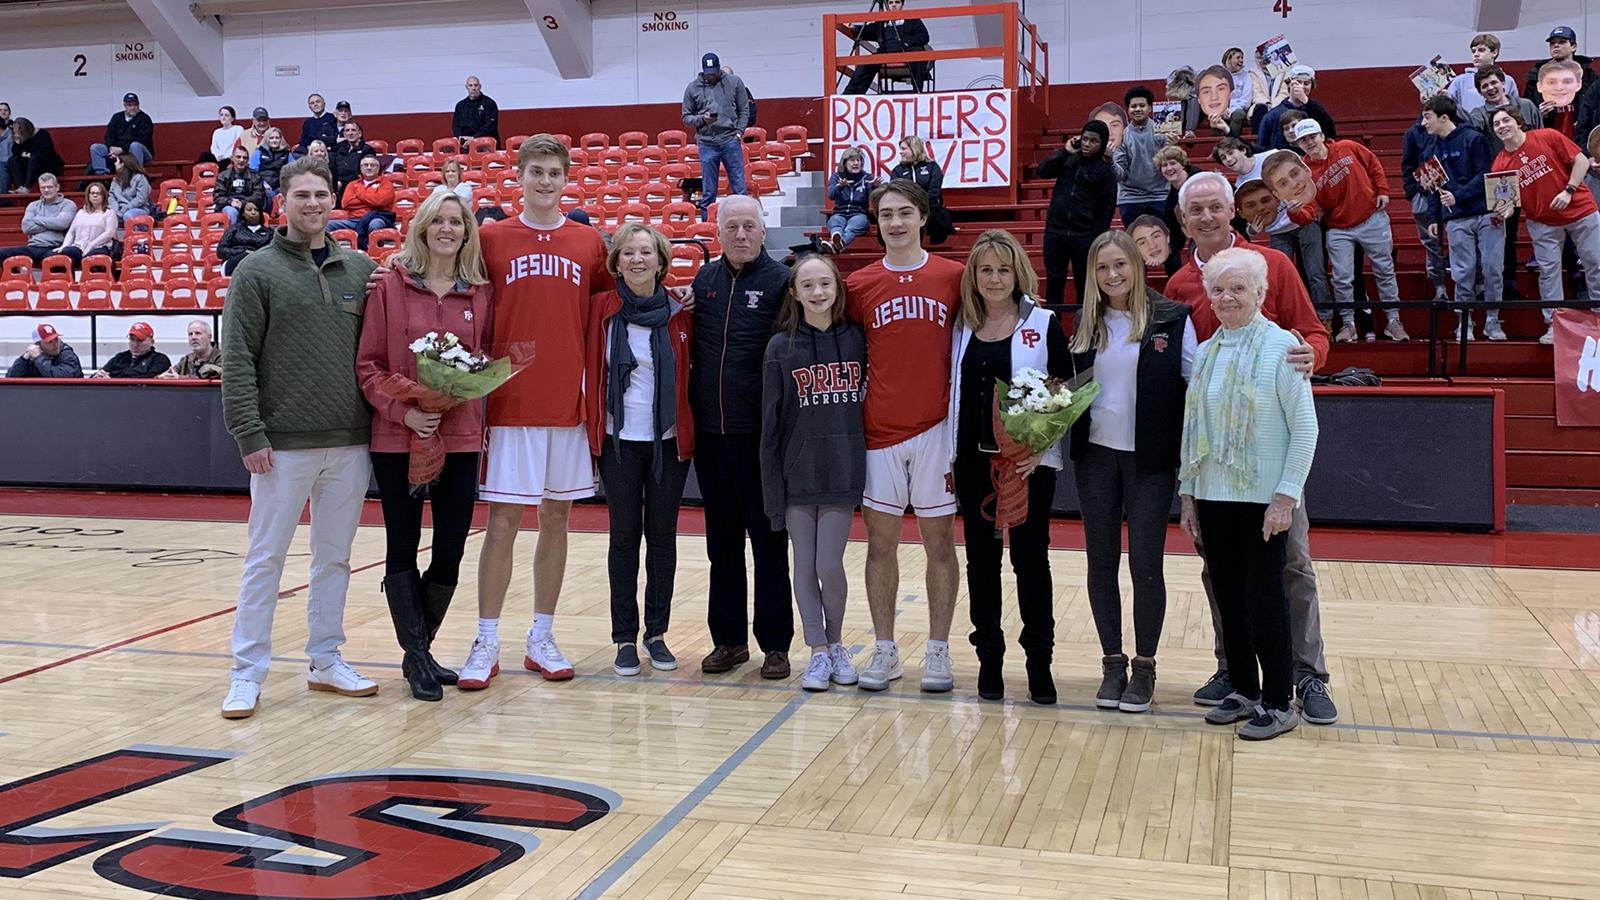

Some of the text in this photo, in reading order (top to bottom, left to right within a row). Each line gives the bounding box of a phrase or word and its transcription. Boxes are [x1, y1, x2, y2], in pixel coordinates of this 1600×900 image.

[653, 11, 677, 21] NO
[1273, 0, 1292, 18] 4
[543, 15, 559, 30] 3
[642, 21, 689, 32] SMOKING
[125, 43, 144, 52] NO
[74, 54, 87, 76] 2
[115, 52, 154, 62] SMOKING
[832, 92, 1008, 142] BROTHERS
[505, 253, 582, 287] JESUITS
[872, 295, 948, 329] JESUITS
[791, 361, 861, 398] PREP
